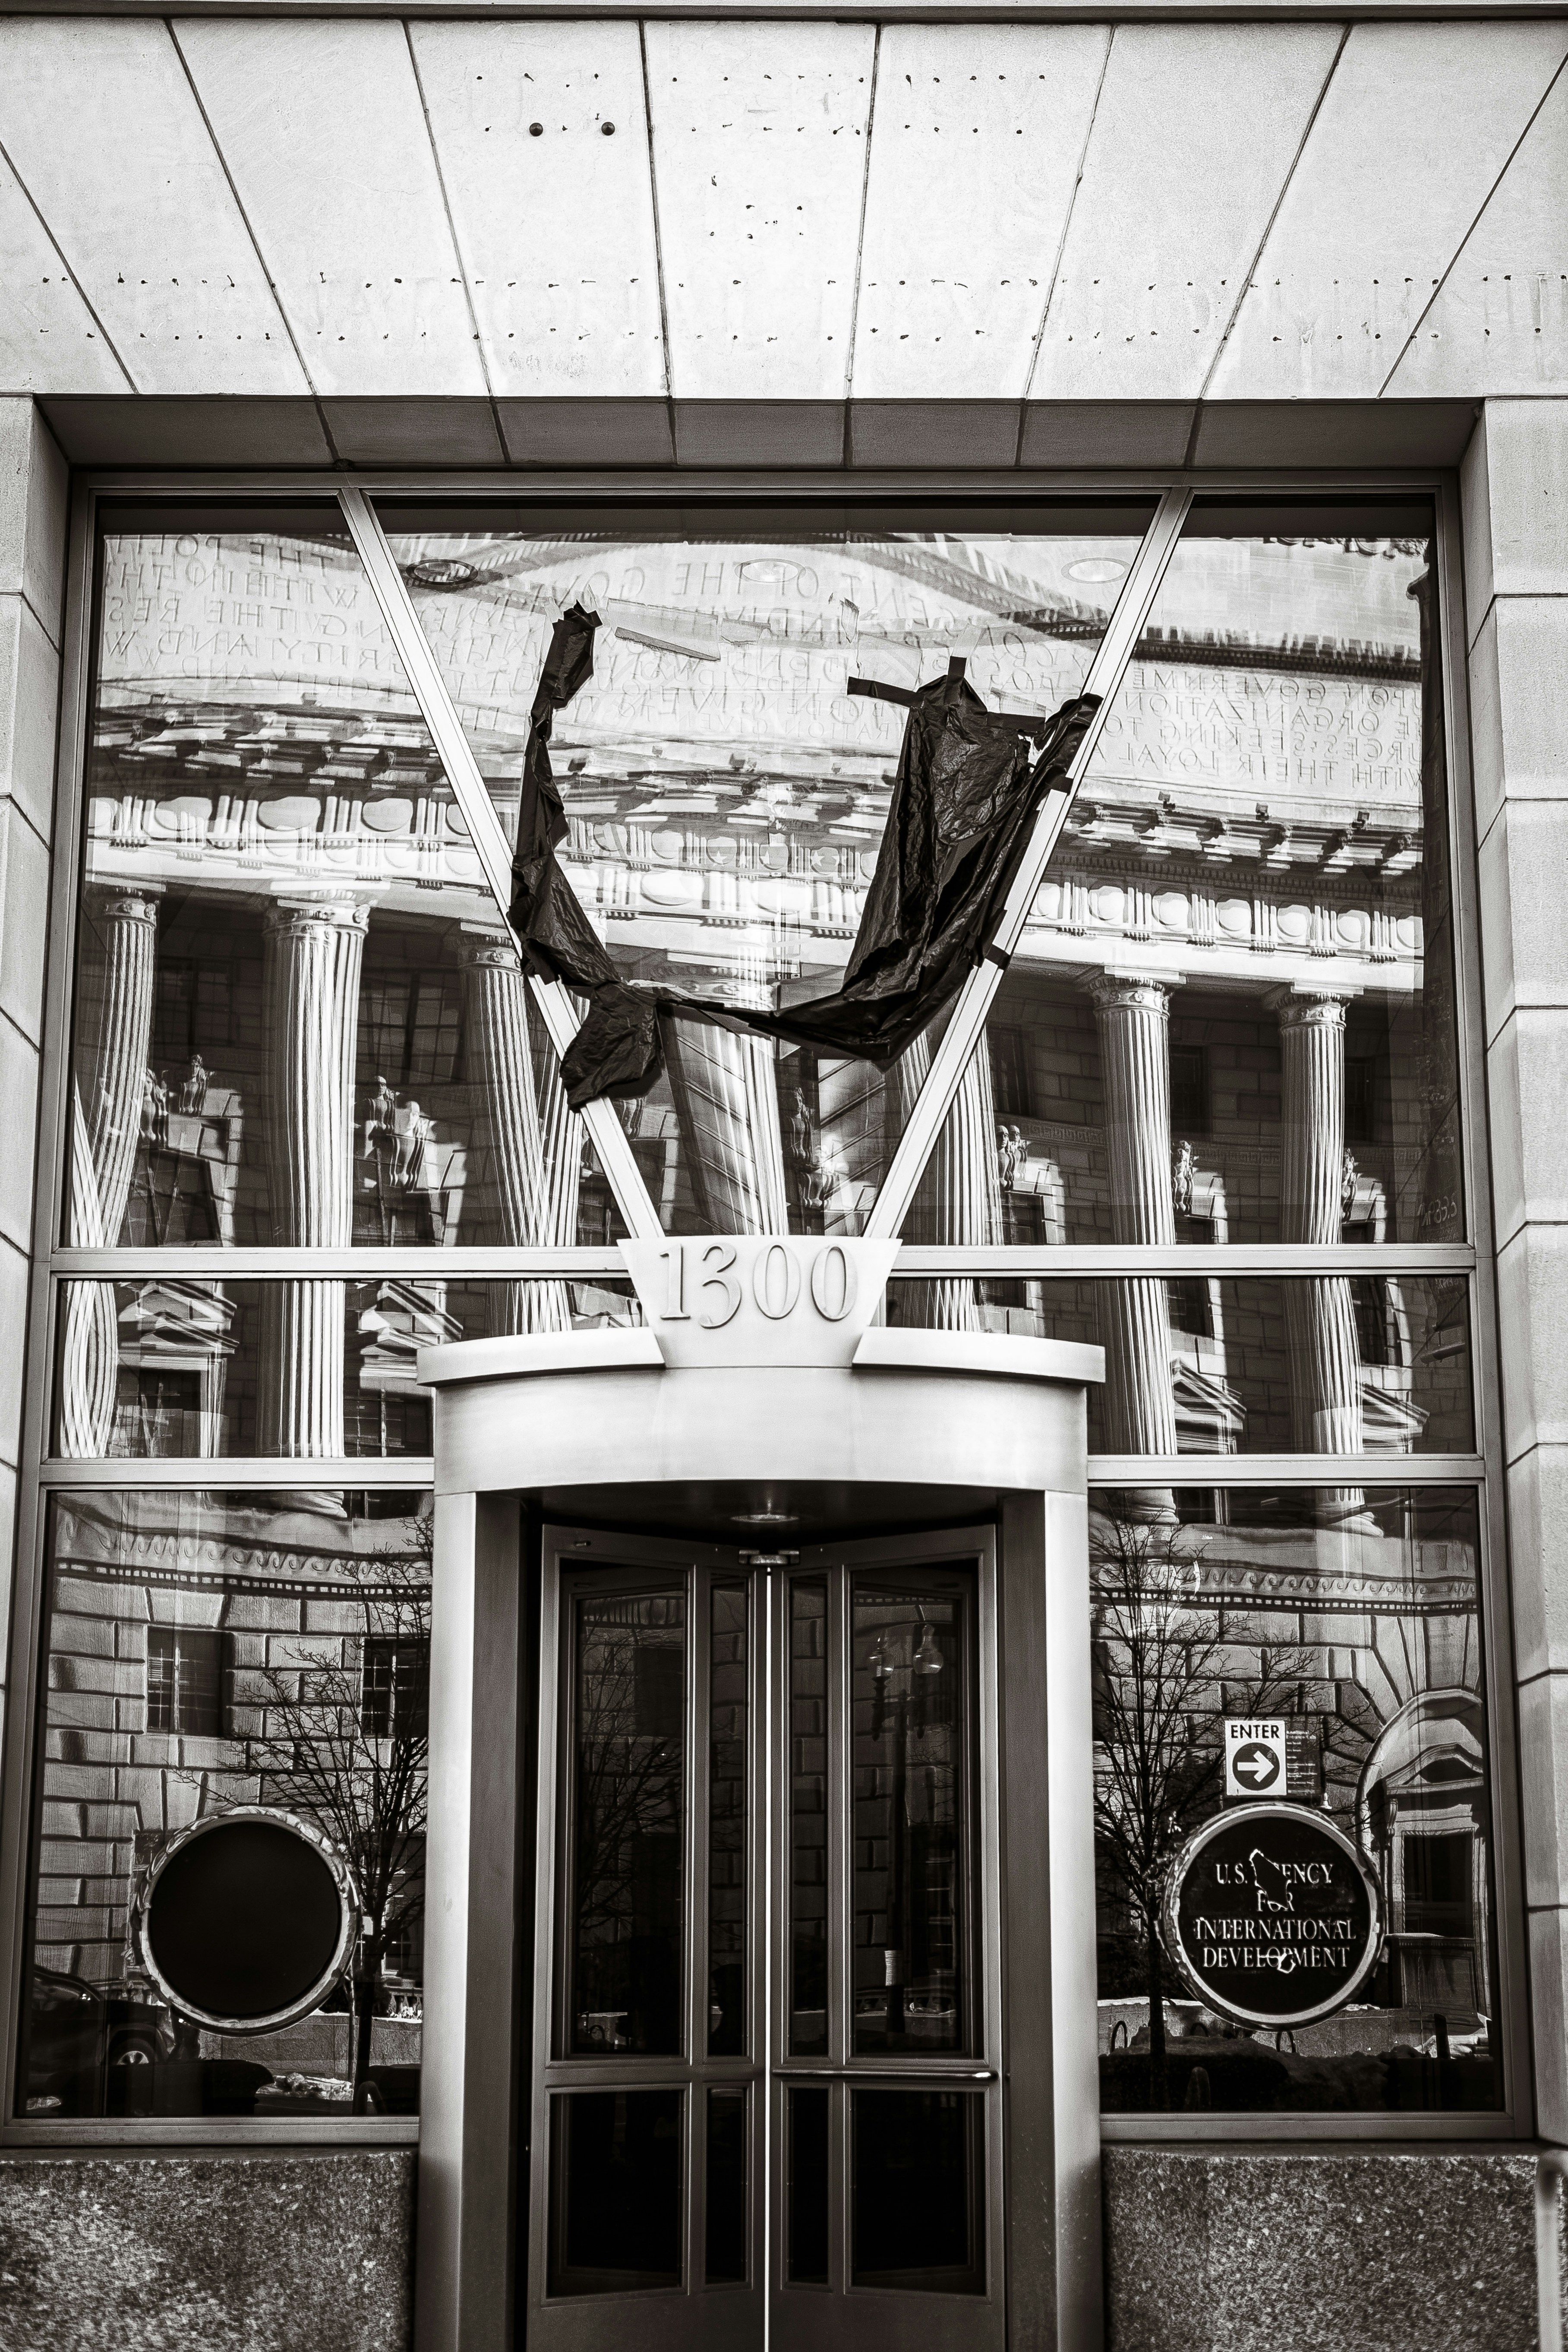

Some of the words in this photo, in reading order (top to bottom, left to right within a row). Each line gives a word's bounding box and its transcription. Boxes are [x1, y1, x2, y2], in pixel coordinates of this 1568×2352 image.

[660, 1242, 858, 1329] 1300
[1230, 1724, 1280, 1739] ENTER
[1195, 1918, 1357, 1939] INTERNATIONAL
